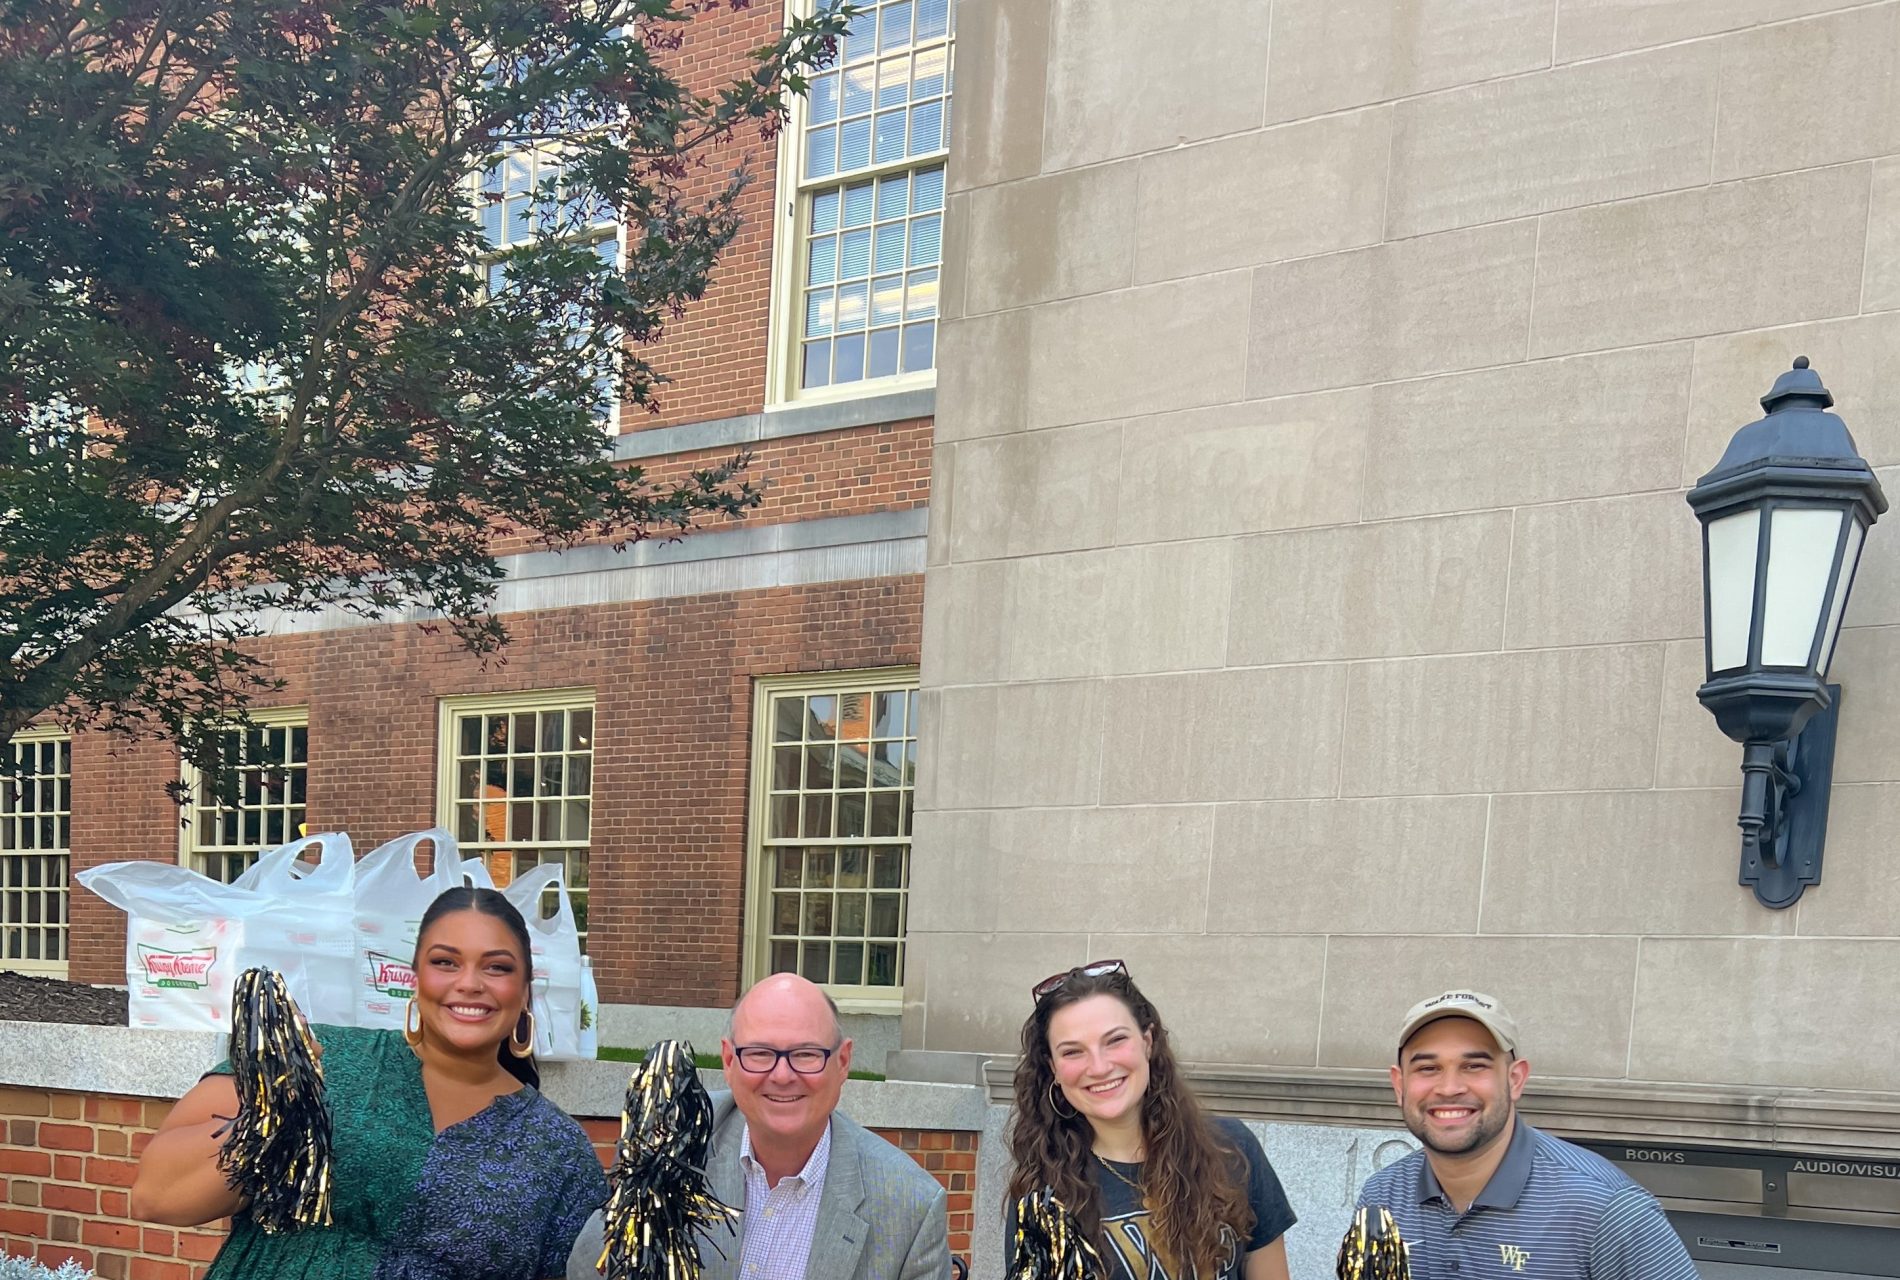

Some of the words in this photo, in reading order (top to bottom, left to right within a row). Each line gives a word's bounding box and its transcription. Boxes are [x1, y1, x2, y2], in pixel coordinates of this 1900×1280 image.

[1625, 1149, 1685, 1163] BOOKS
[1793, 1160, 1900, 1178] AUDIO/VISU
[1498, 1244, 1531, 1273] WF
